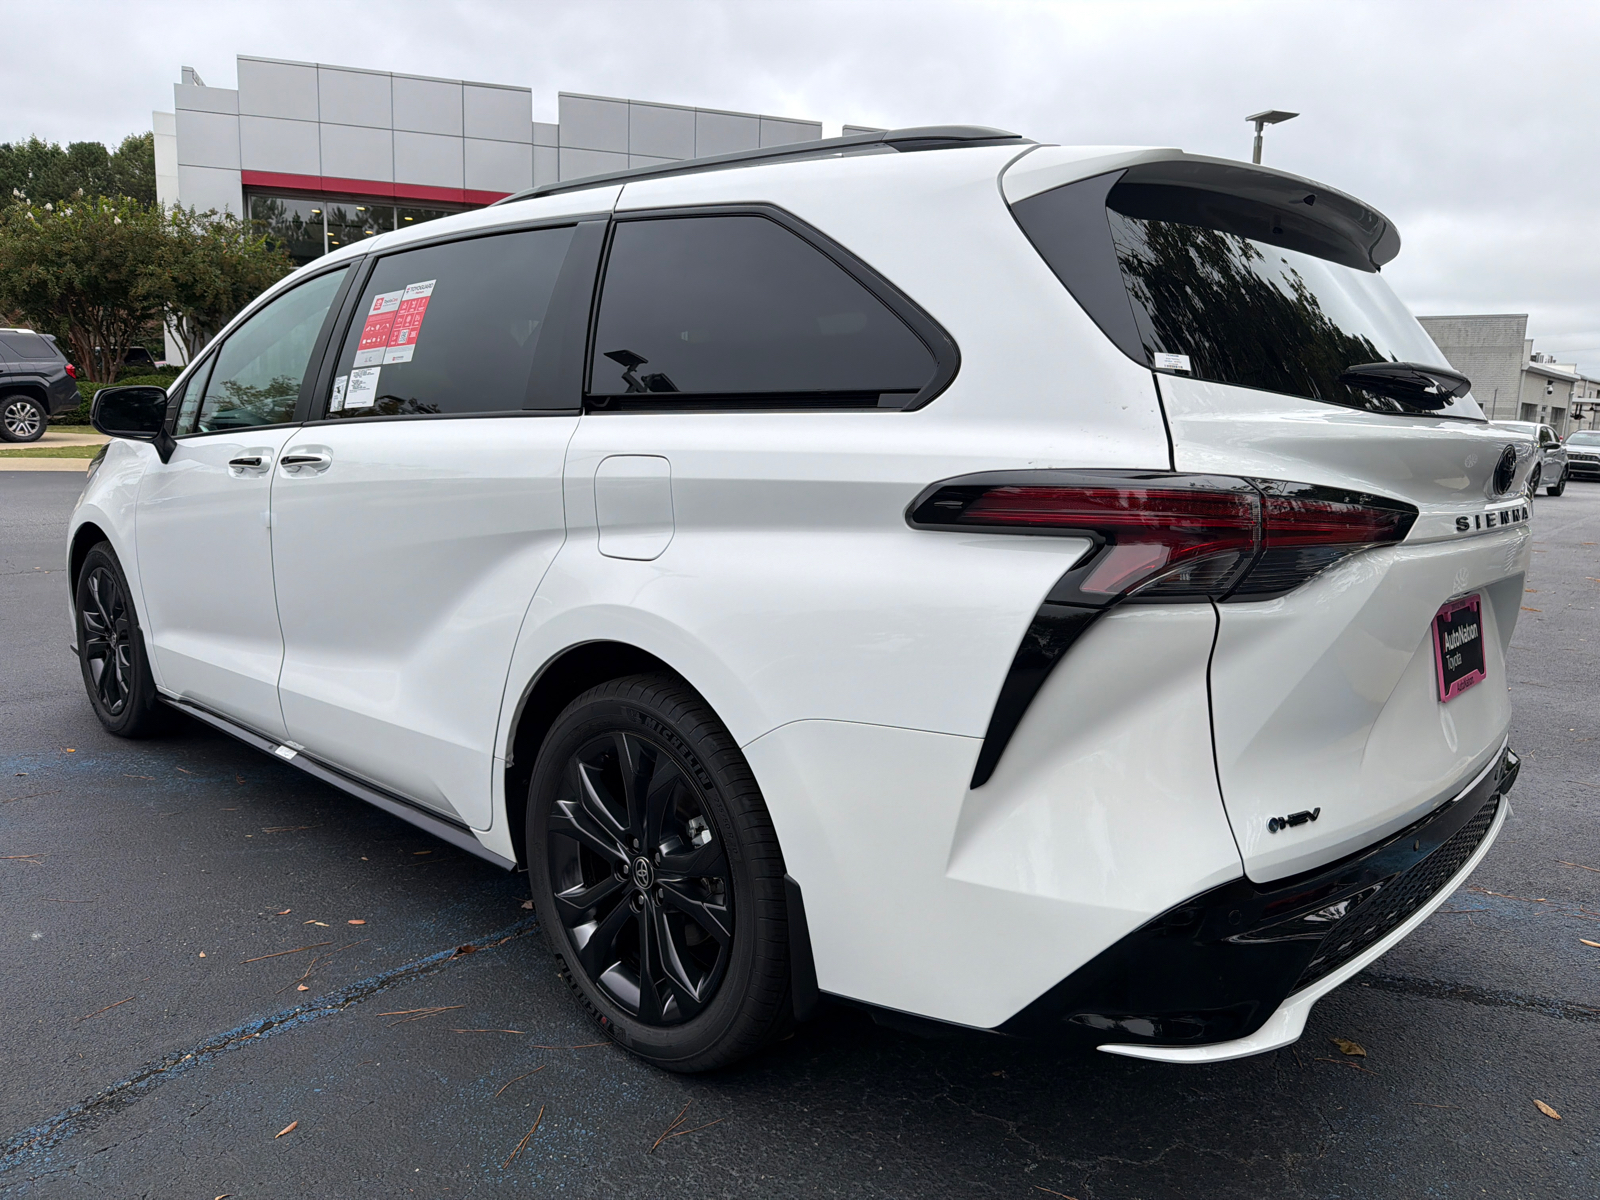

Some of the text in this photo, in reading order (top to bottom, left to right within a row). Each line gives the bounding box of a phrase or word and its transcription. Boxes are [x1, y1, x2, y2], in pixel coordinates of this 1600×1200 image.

[1456, 506, 1529, 532] SIENNA
[1444, 622, 1478, 653] AutoNation
[1446, 652, 1462, 671] Toyota
[644, 715, 710, 786] MICHELIN
[1277, 806, 1321, 830] HEV
